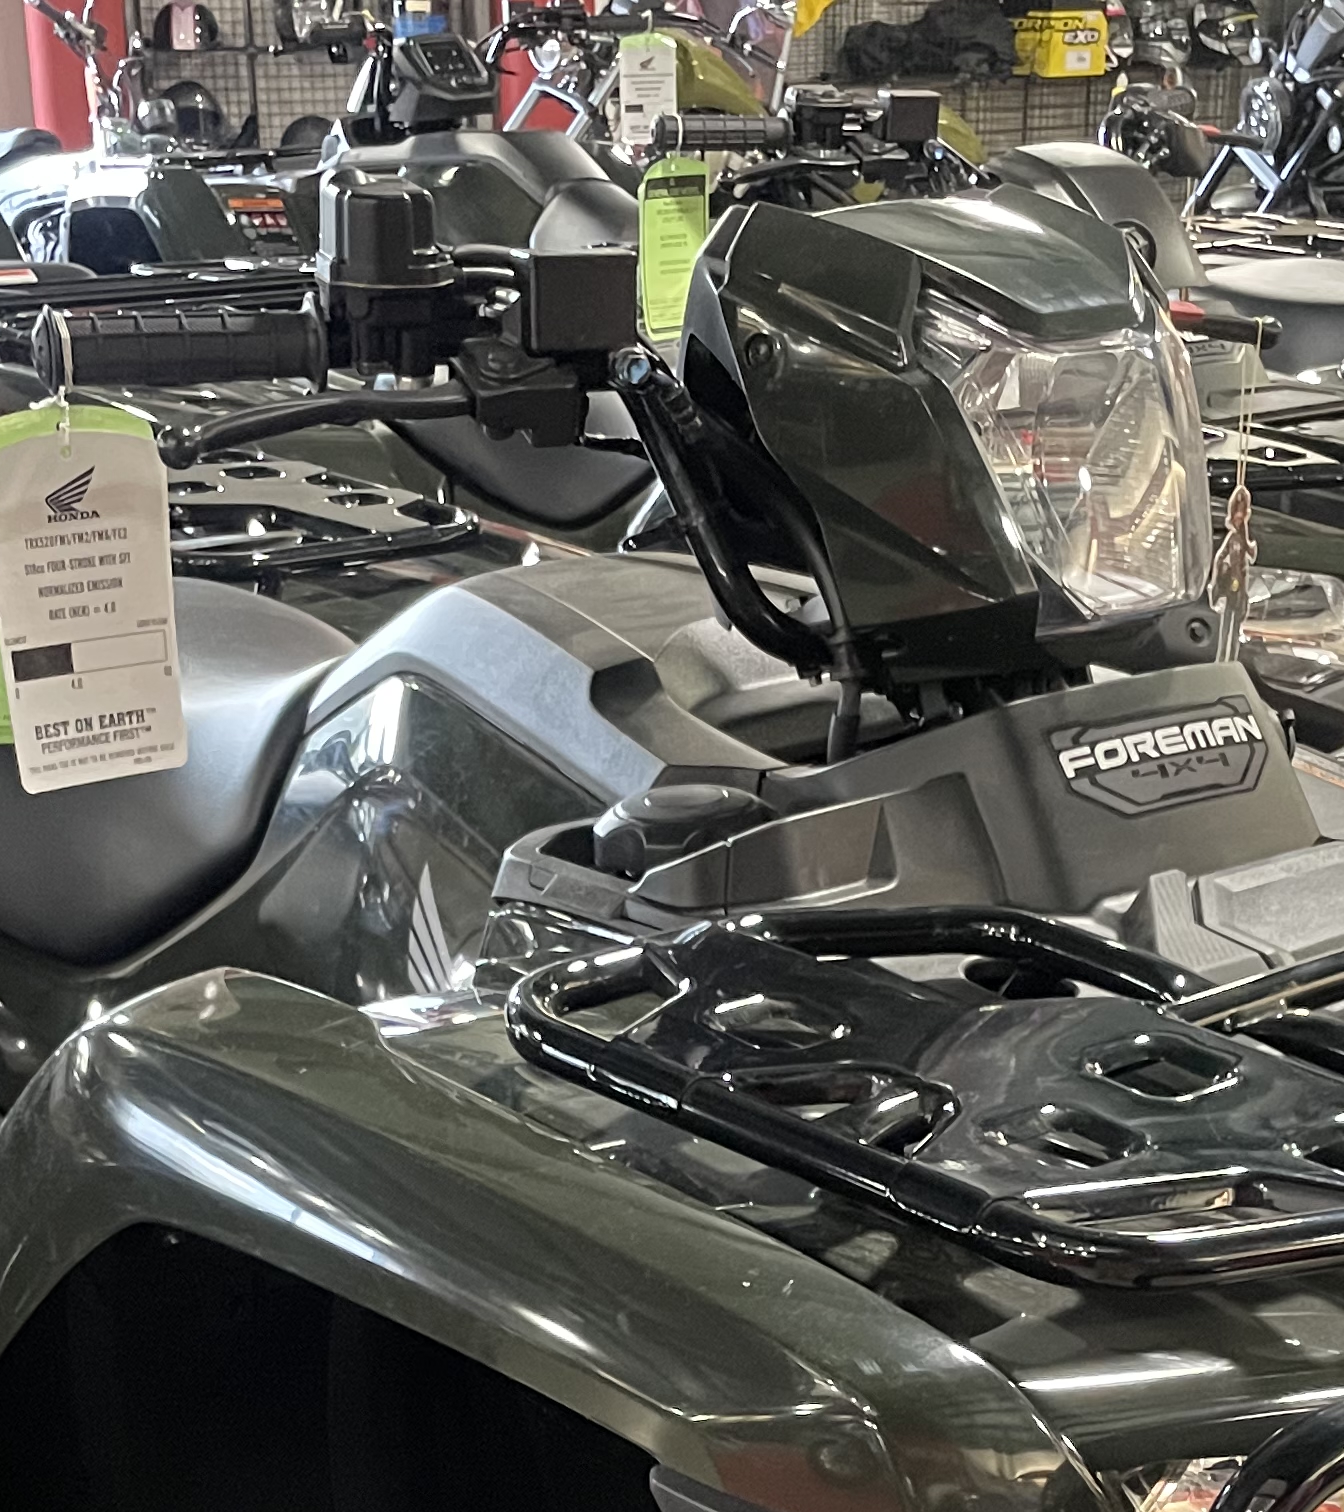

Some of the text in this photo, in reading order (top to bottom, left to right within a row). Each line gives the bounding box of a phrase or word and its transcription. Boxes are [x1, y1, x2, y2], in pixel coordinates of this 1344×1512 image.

[1063, 30, 1099, 44] EXO
[47, 510, 101, 524] HONDA
[34, 720, 70, 741] BEST
[75, 716, 93, 734] ON
[41, 732, 112, 755] PERFORMANCE
[1058, 714, 1264, 779] FOREMAN
